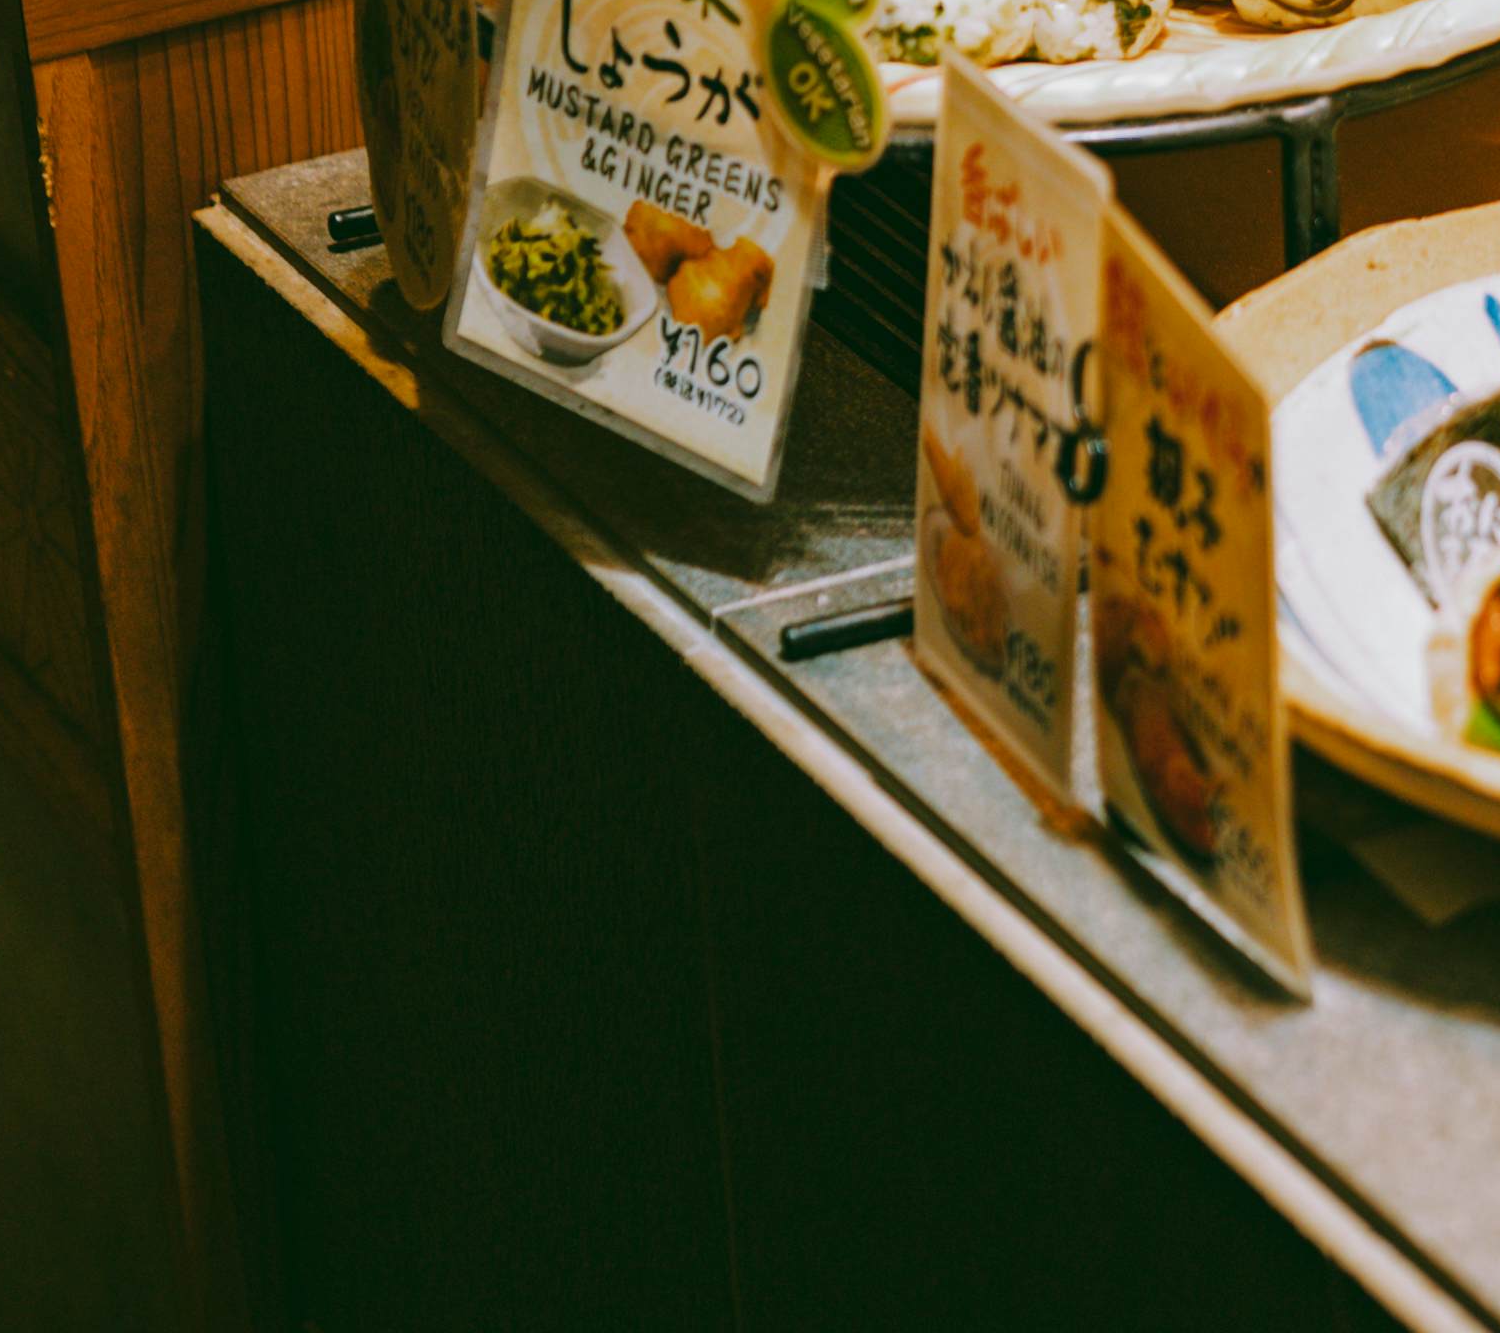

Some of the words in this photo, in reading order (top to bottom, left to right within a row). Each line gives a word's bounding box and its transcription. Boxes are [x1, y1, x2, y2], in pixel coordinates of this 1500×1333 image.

[787, 61, 836, 123] OK
[526, 67, 656, 152] MUSTARD
[665, 133, 787, 215] GREENS
[580, 147, 713, 225] &GINGER
[661, 315, 761, 400] ¥160
